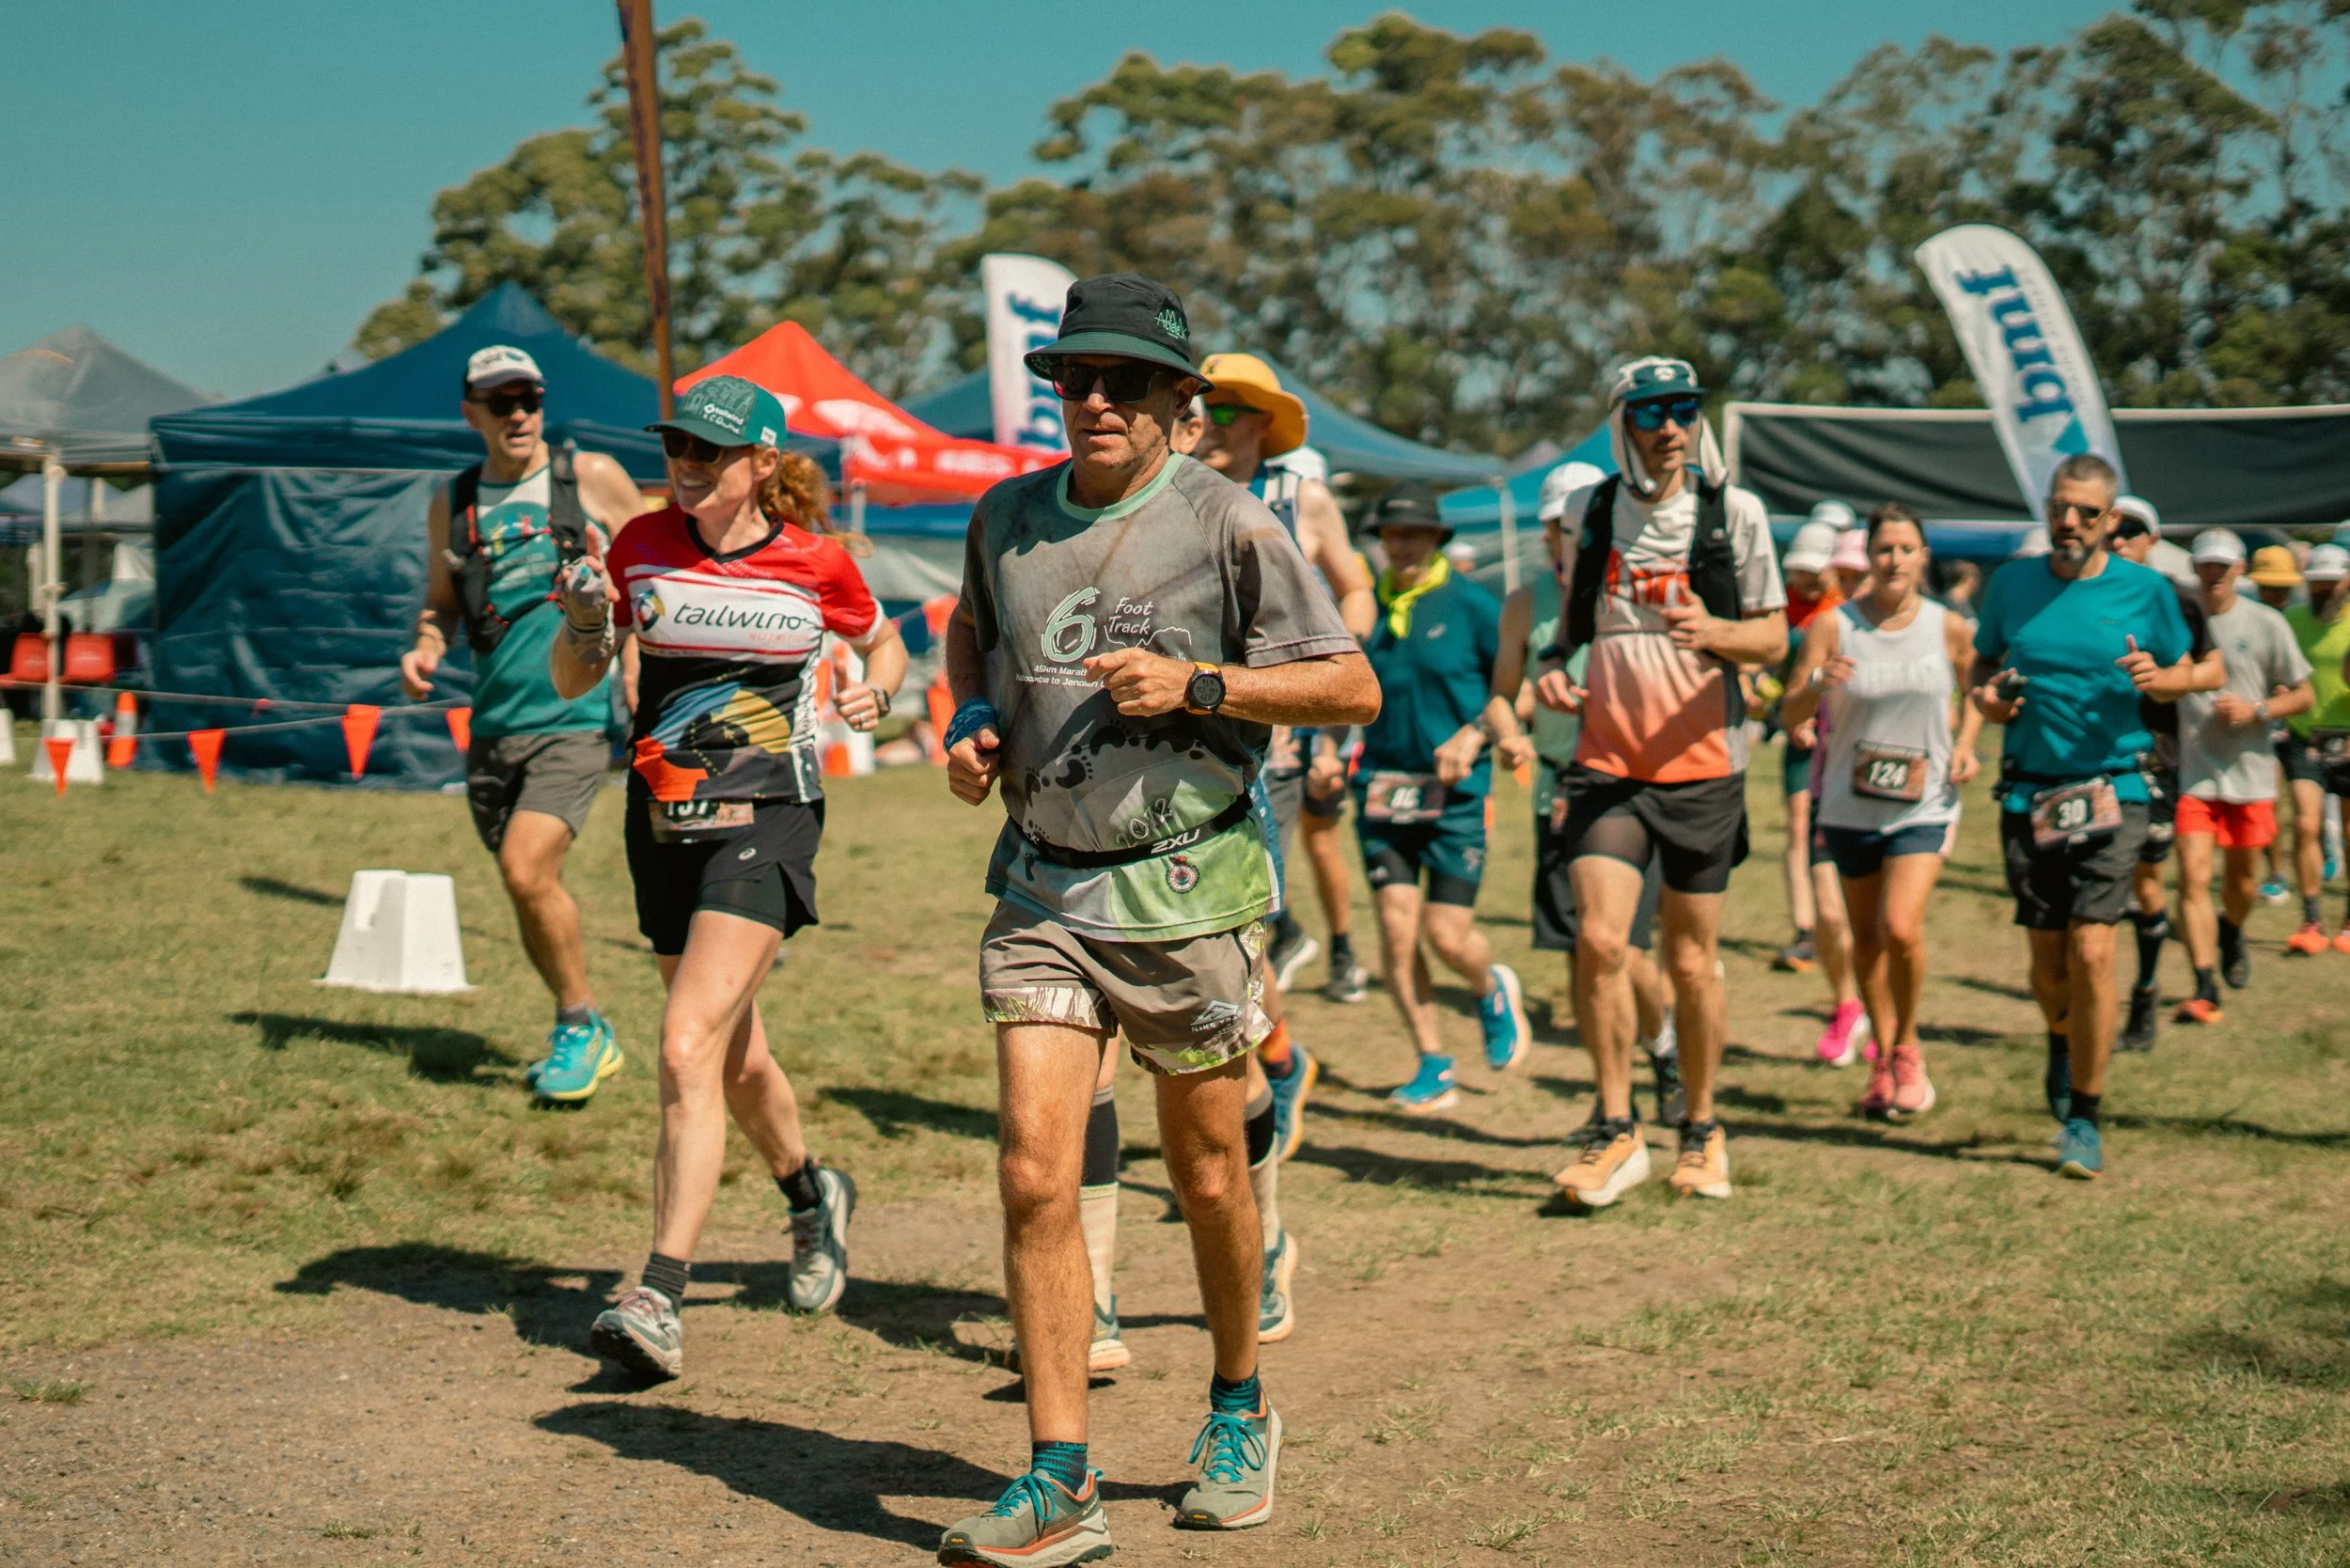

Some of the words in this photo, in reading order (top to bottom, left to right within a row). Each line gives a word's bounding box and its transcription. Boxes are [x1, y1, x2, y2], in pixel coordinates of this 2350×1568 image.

[1115, 596, 1153, 616] Foot
[1108, 616, 1151, 635] Track
[1034, 665, 1057, 673] 45km
[1059, 666, 1088, 676] Marat
[1051, 676, 1060, 684] to
[1868, 760, 1908, 788] 124
[2059, 798, 2087, 828] 30
[1150, 828, 1200, 855] 2XU
